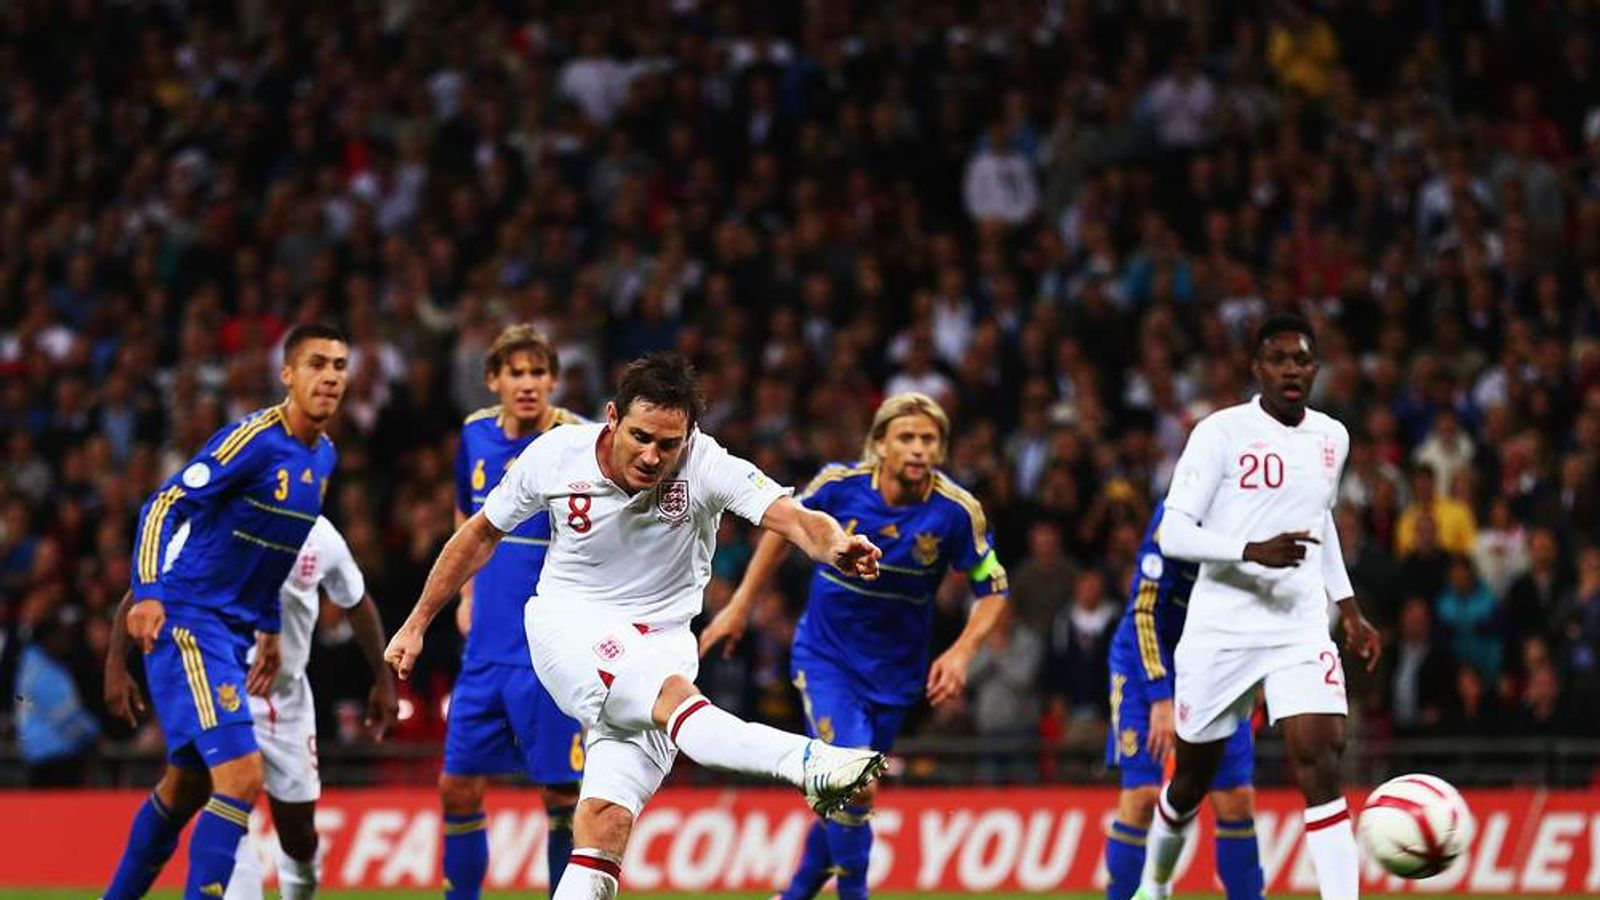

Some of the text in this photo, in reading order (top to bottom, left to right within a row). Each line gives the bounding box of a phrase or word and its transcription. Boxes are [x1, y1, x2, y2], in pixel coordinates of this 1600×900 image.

[274, 468, 289, 501] 3
[471, 459, 486, 490] 6
[1239, 452, 1284, 489] 20
[568, 493, 592, 533] 8
[1319, 650, 1345, 686] 2
[570, 732, 585, 772] 6
[342, 809, 441, 888] FA
[917, 808, 1085, 891] YOU
